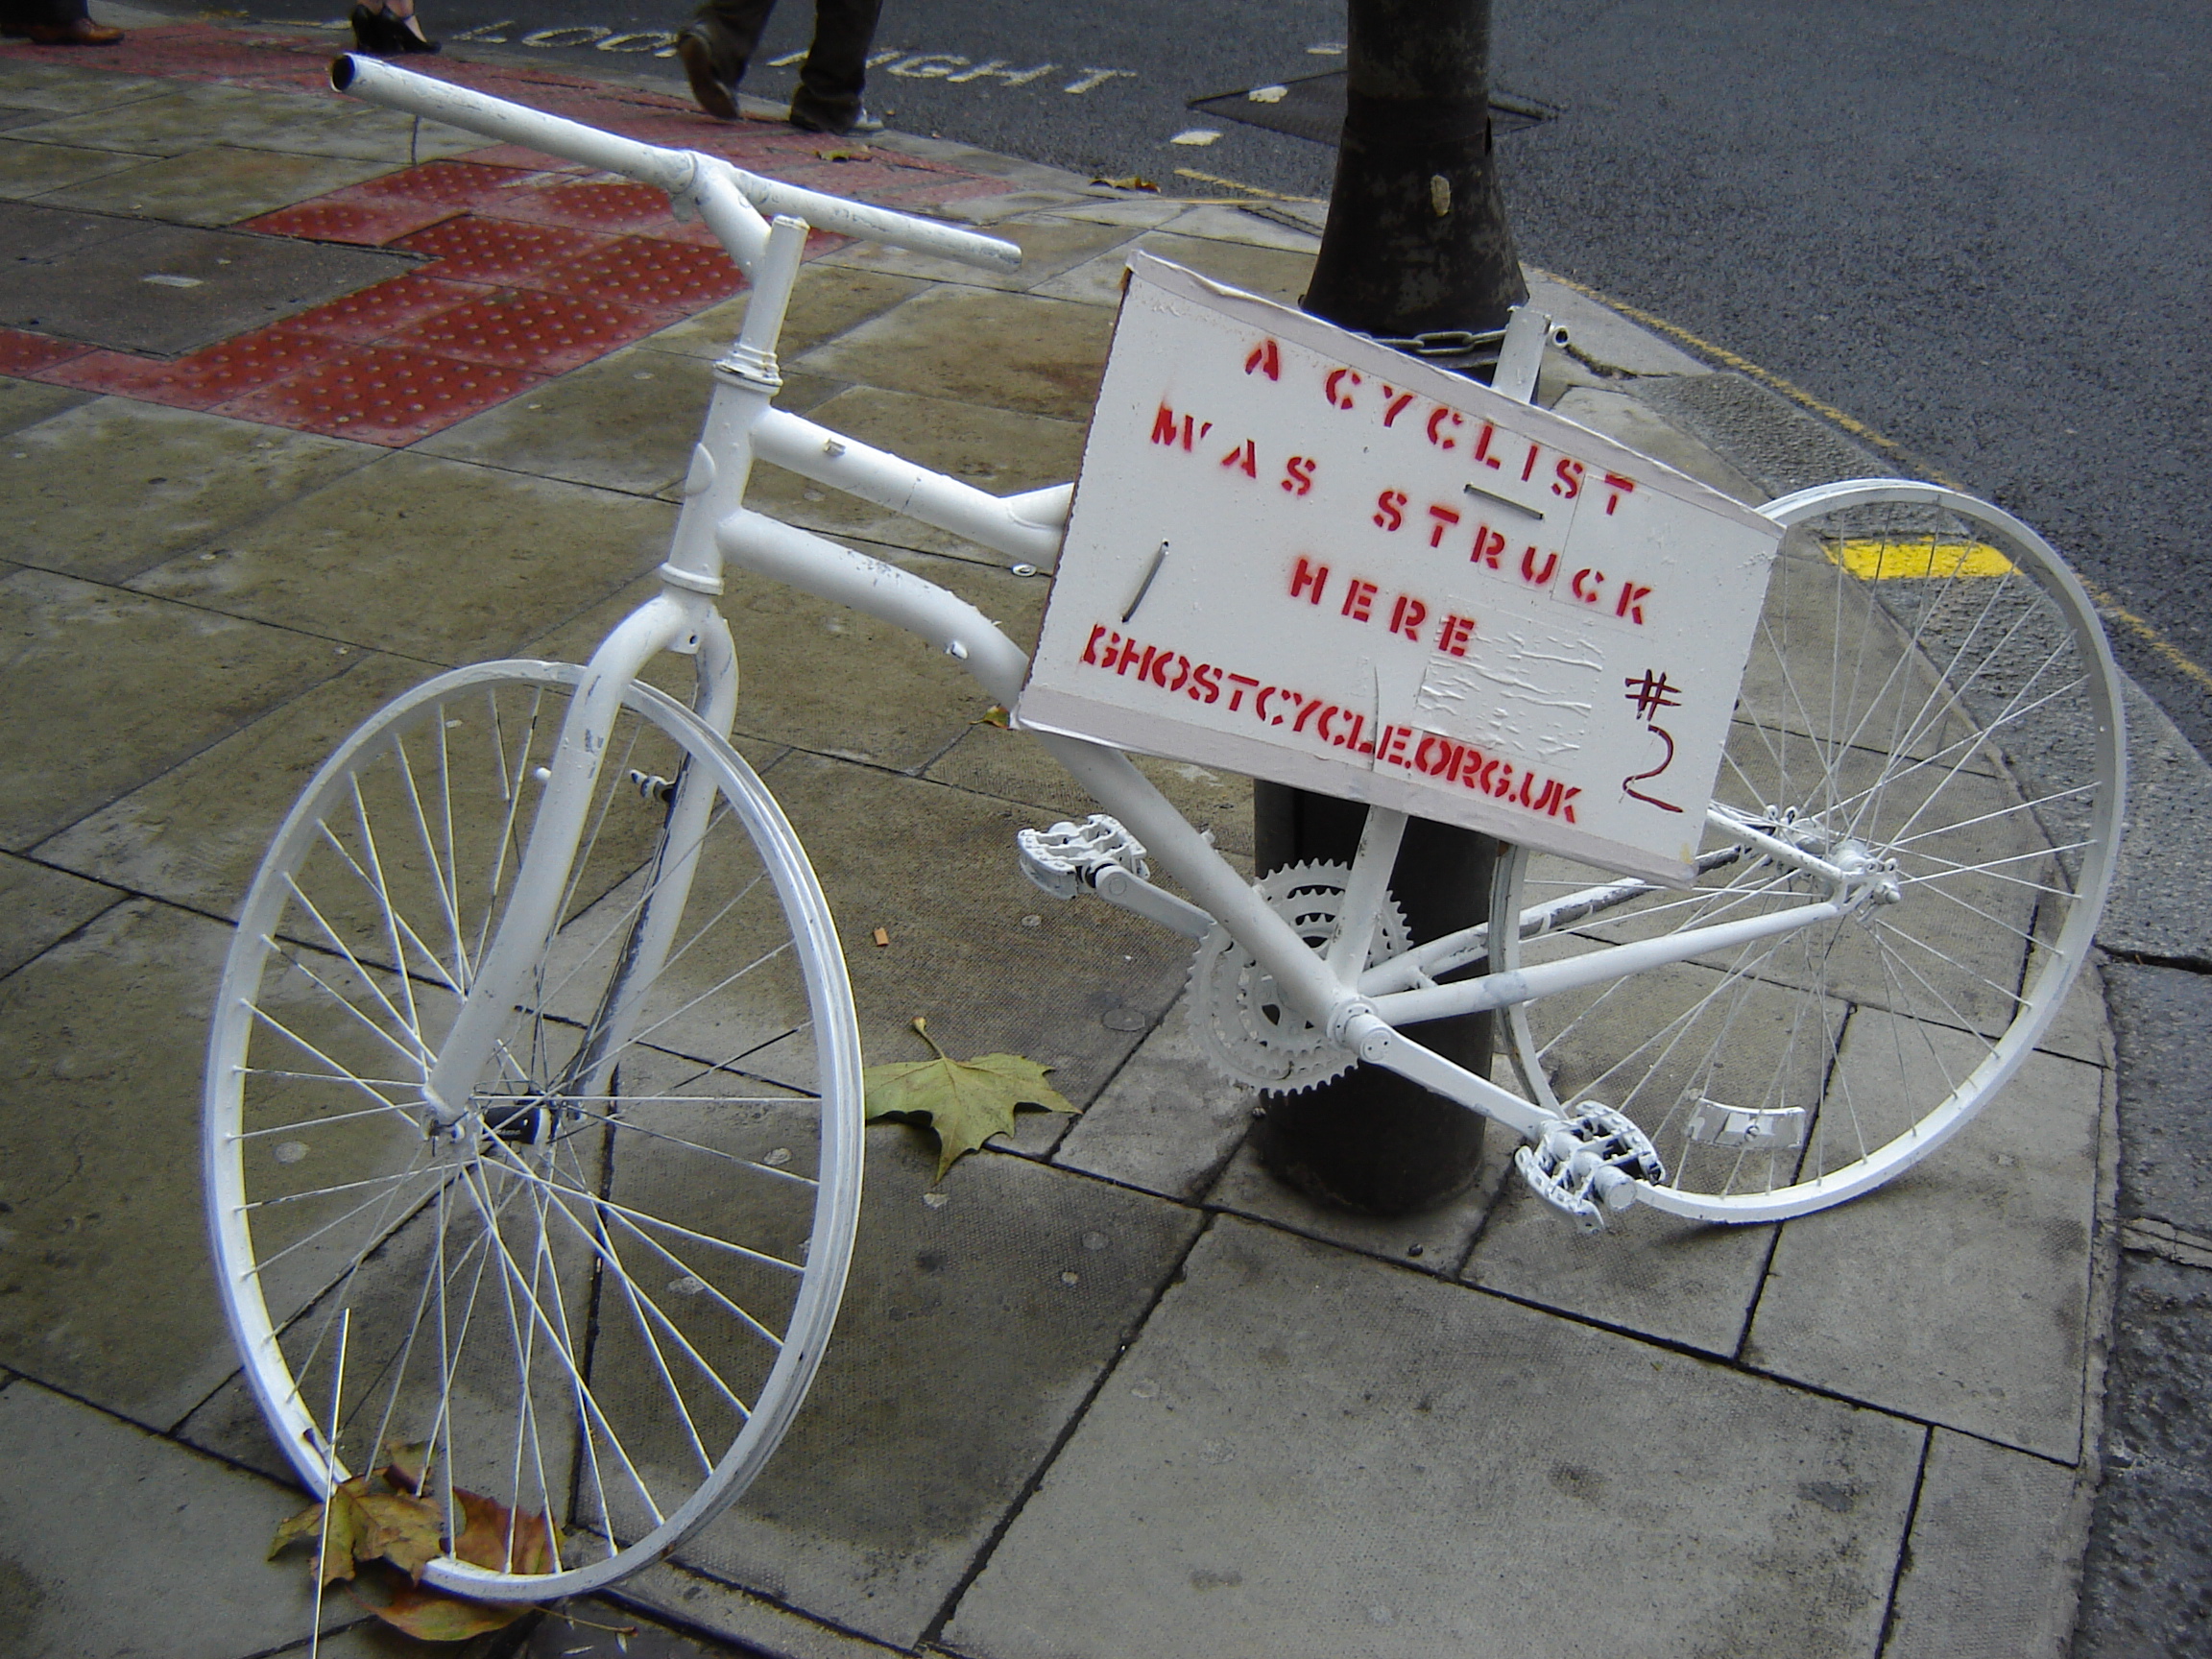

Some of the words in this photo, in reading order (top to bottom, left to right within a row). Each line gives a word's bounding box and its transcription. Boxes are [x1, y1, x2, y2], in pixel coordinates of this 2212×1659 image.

[452, 19, 679, 59] LOO
[1150, 401, 1317, 496] WAS
[1373, 489, 1654, 627] STRUCK
[1244, 339, 1282, 382] A
[1324, 369, 1636, 517] CYCLIST
[1288, 555, 1476, 660] HERE
[1081, 623, 1583, 825] GHOSTCYCLE.ORG.UK
